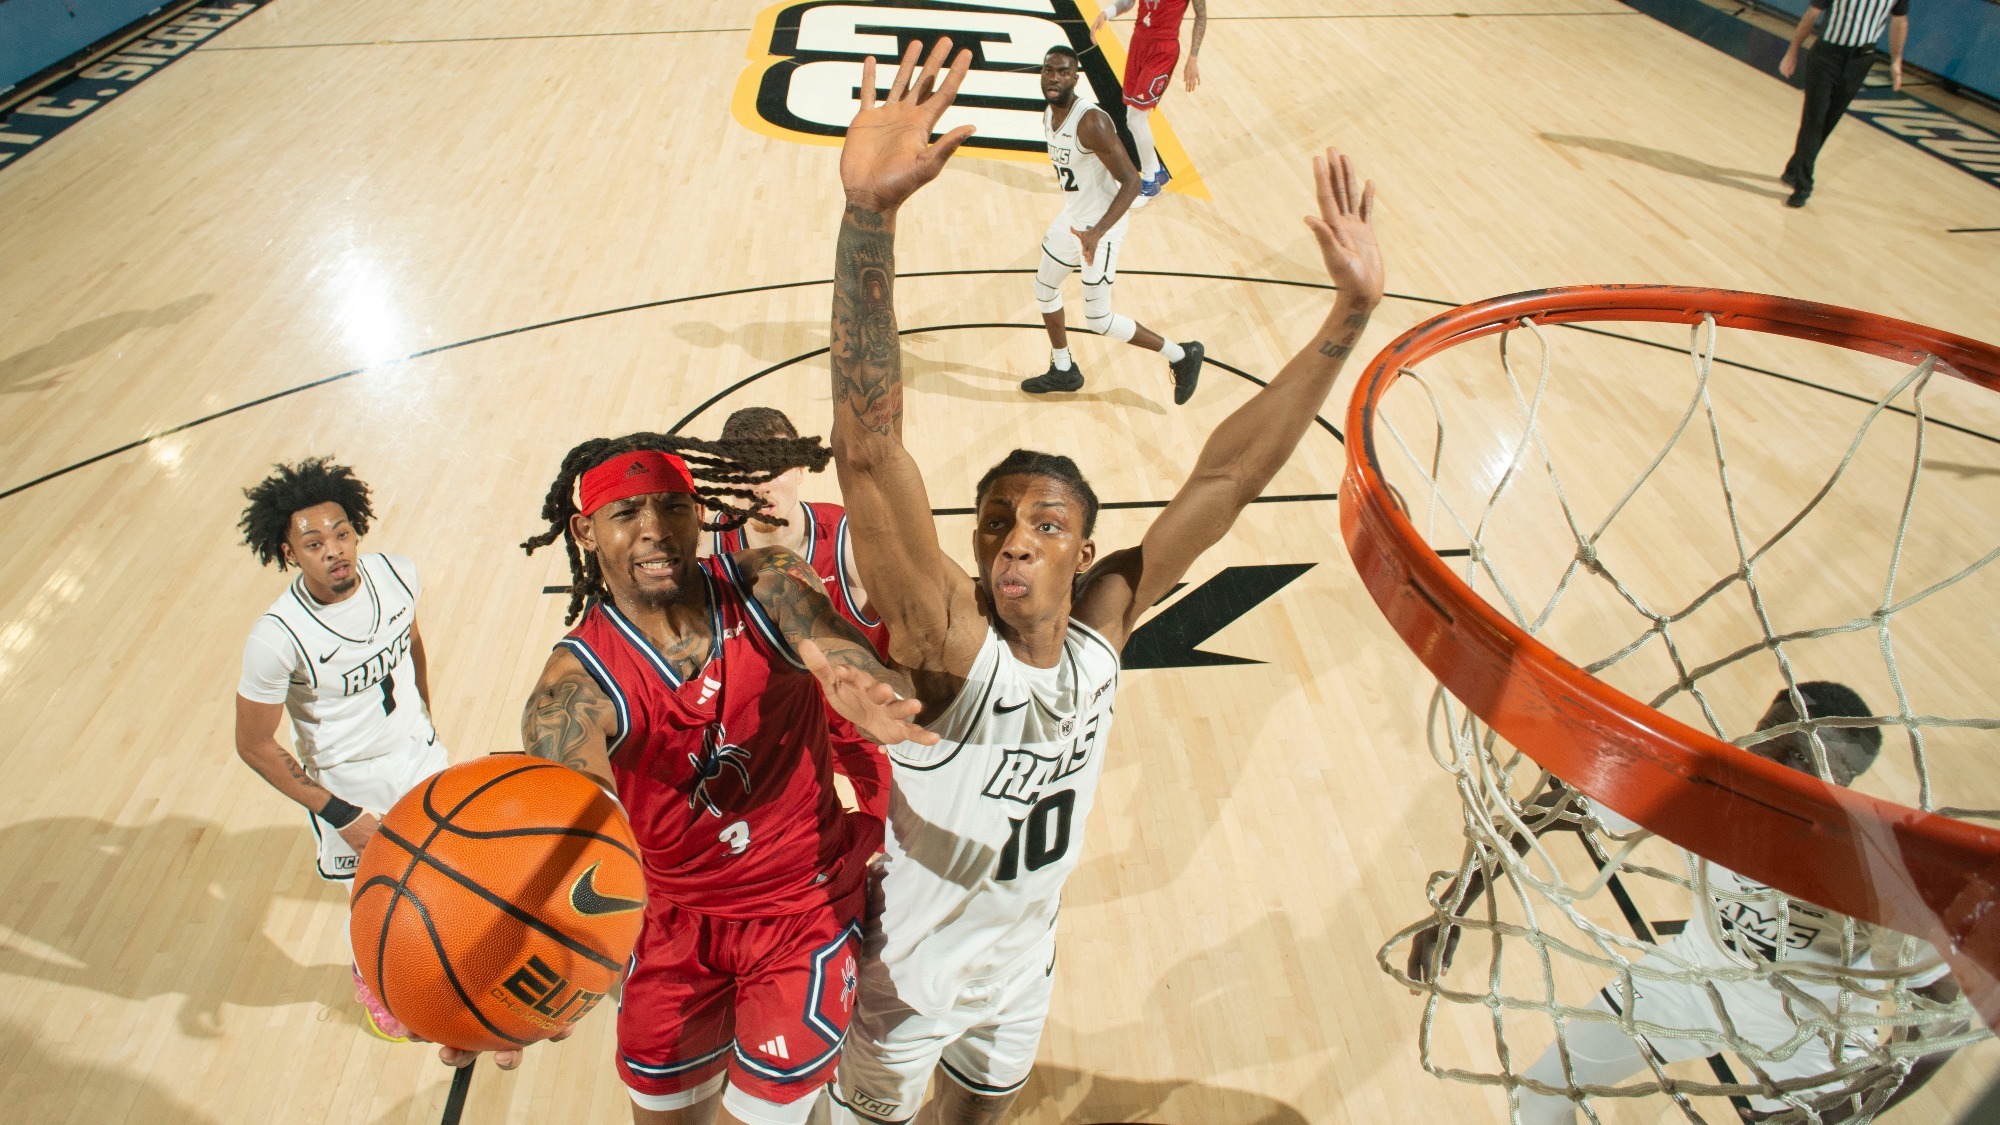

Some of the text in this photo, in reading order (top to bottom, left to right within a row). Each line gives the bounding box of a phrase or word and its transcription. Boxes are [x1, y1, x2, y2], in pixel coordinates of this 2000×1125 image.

[78, 3, 257, 82] SIEGEL
[1048, 144, 1071, 165] AMS
[342, 623, 411, 697] RAMS
[379, 671, 397, 718] 1
[718, 820, 751, 858] 3
[994, 788, 1077, 881] 10
[1715, 896, 1821, 950] AMS
[851, 1087, 901, 1117] VCU
